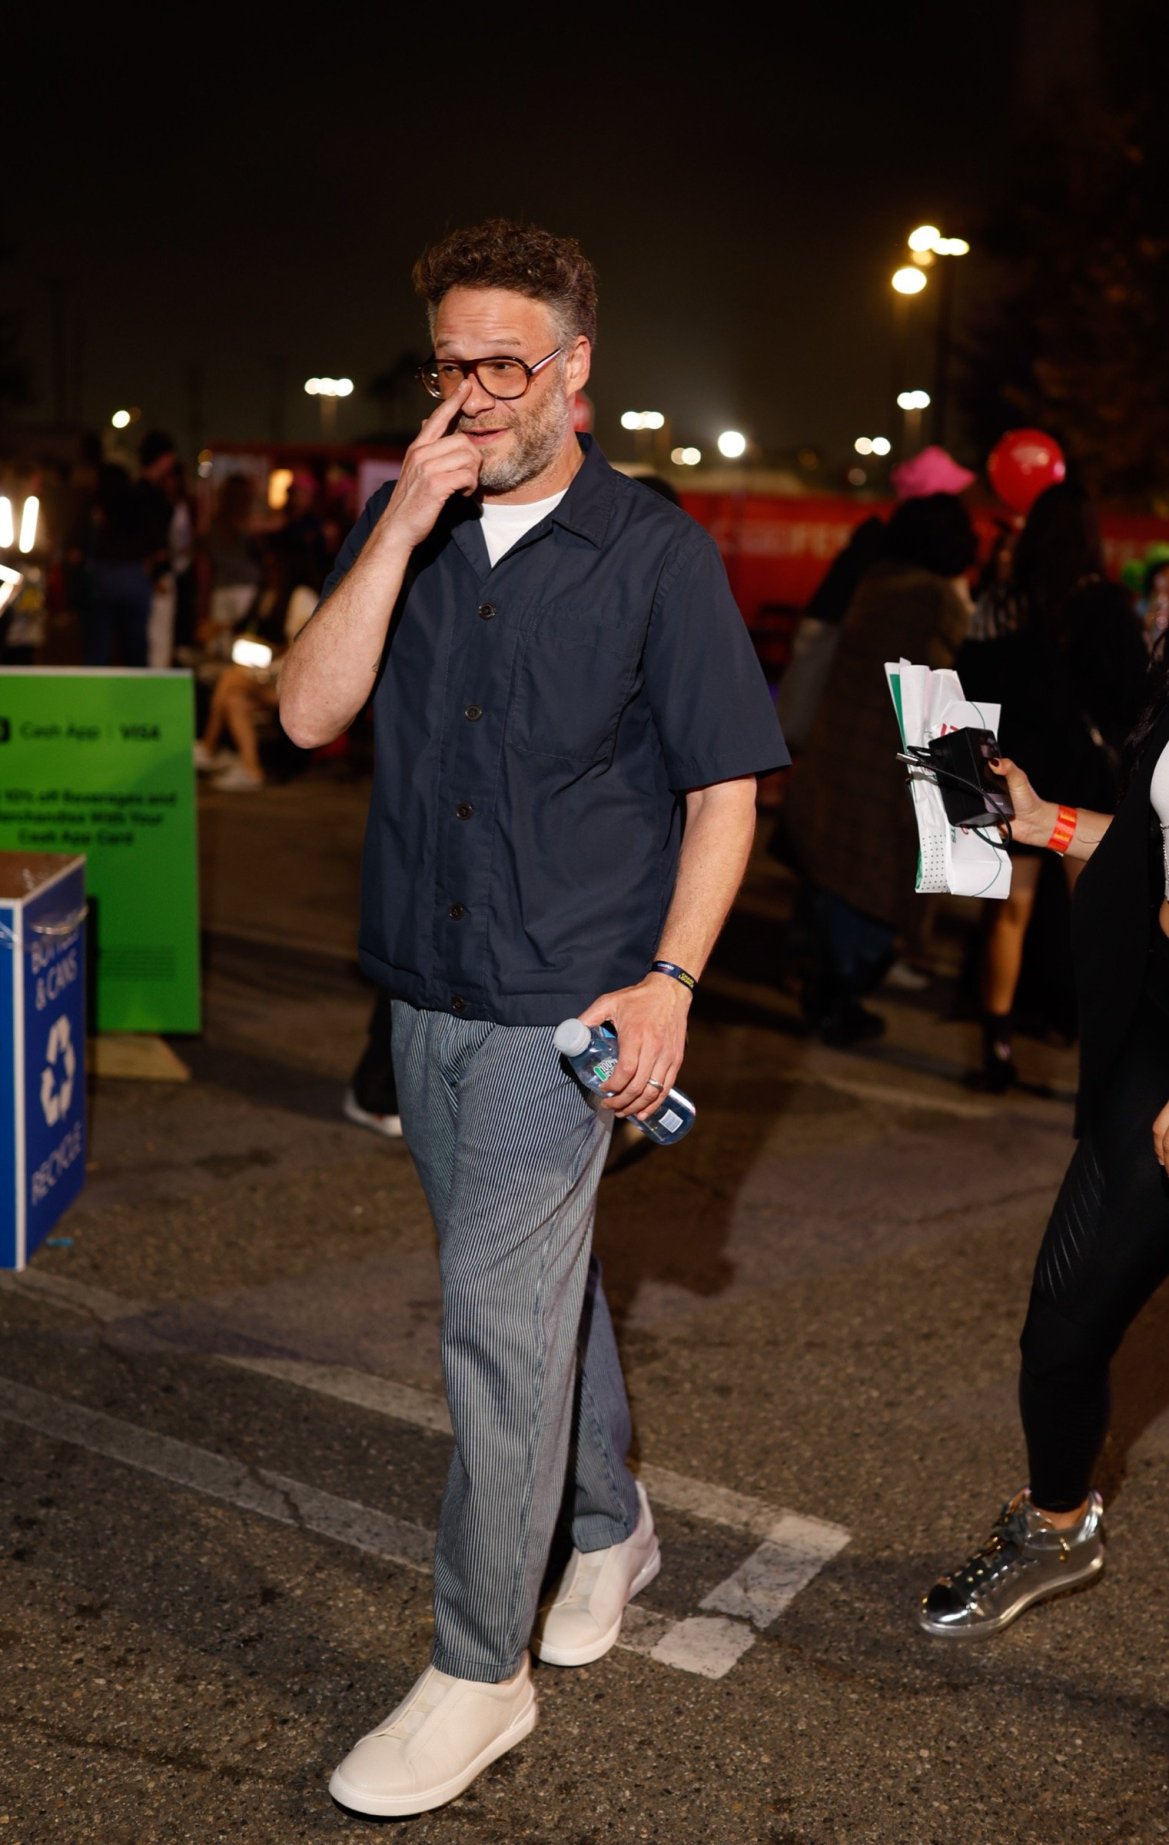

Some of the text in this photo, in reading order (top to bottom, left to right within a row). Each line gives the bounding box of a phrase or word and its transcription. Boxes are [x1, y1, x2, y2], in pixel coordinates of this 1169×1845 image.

[20, 721, 162, 743] Cash App VISA
[18, 828, 57, 846] Cash
[62, 829, 92, 847] App
[35, 977, 47, 1011] &
[46, 946, 78, 1000] CANS
[31, 1120, 82, 1208] RECYCLE
